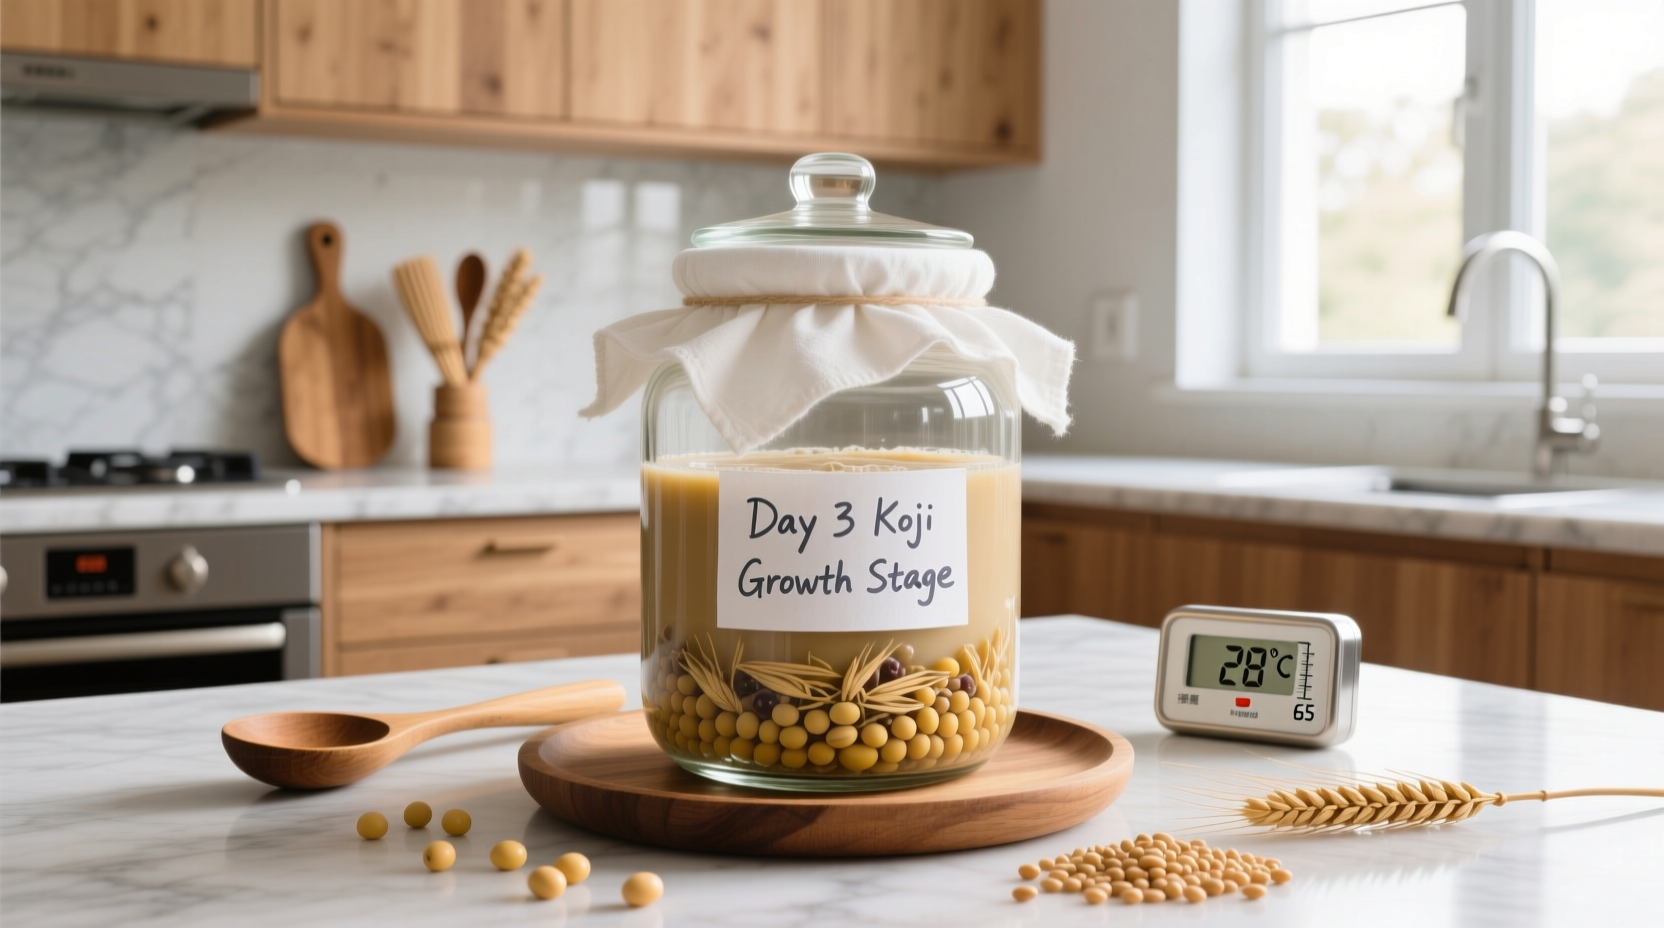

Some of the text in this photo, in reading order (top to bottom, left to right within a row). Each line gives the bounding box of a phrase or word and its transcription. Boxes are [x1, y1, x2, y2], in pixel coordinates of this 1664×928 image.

[747, 497, 933, 554] Day 3 Koji
[738, 558, 955, 607] Growth Stage
[1293, 703, 1315, 722] 65
